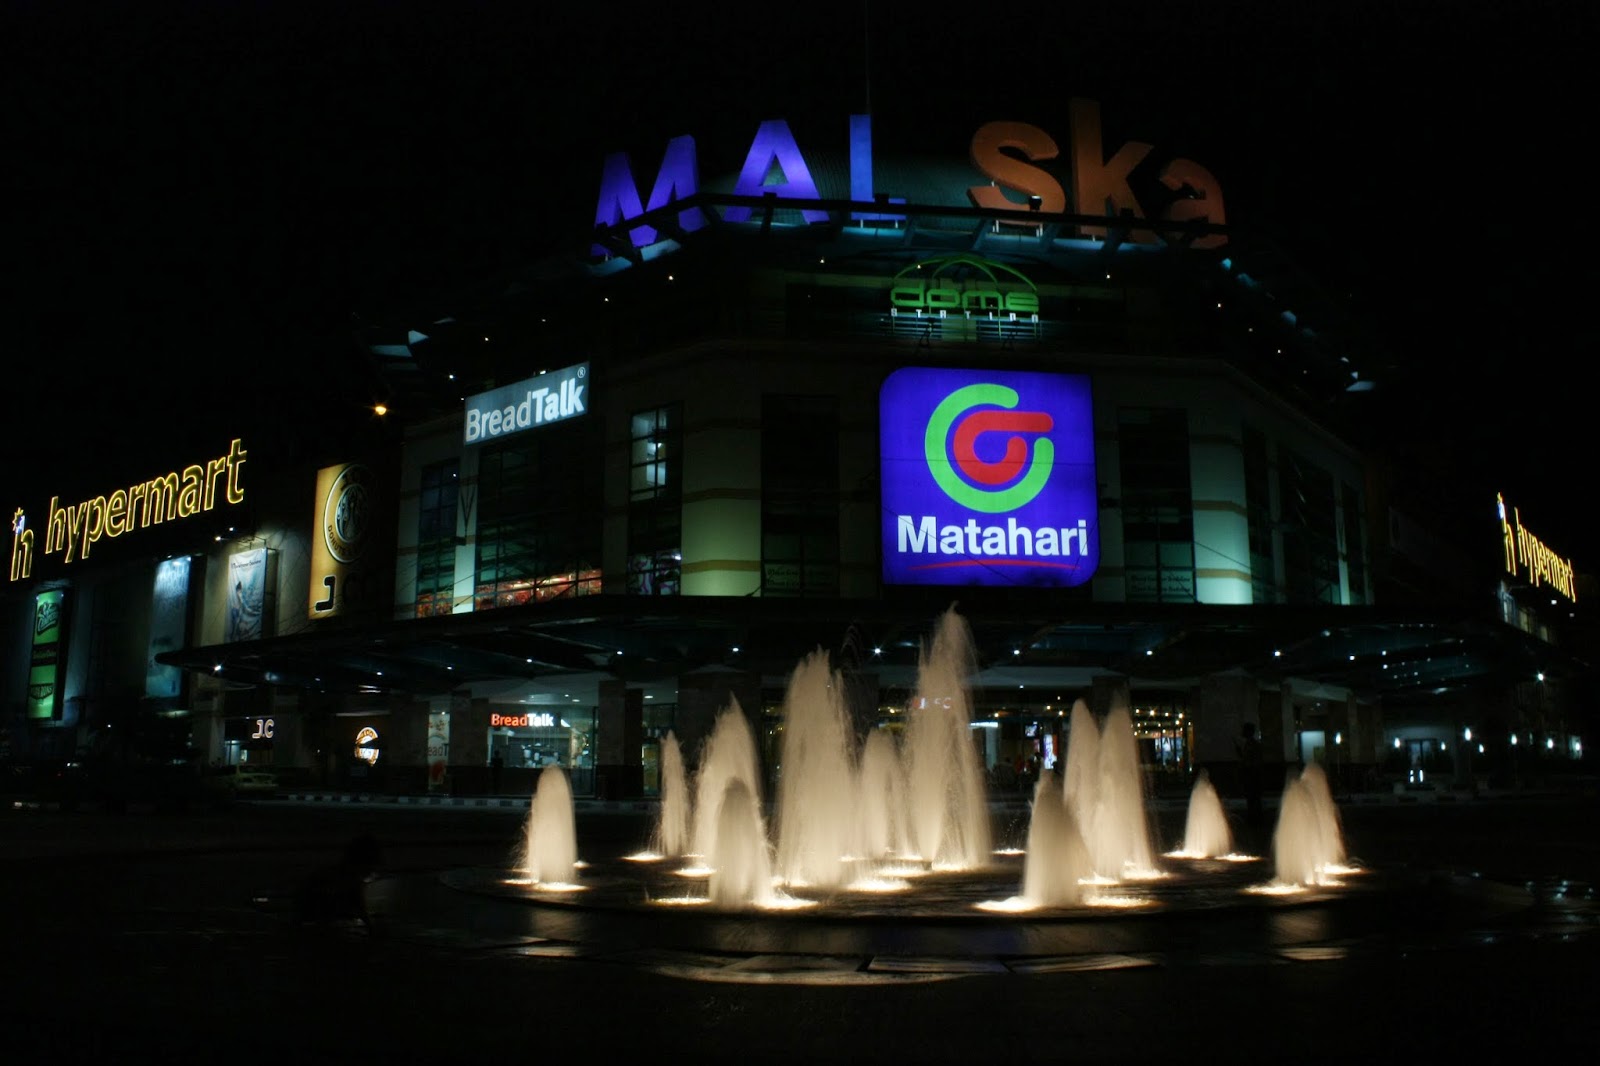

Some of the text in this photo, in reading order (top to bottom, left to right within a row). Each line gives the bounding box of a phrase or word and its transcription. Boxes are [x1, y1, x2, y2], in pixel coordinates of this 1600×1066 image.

[591, 113, 907, 256] MAL
[890, 282, 1040, 312] dome
[465, 376, 585, 442] BreadTalk
[44, 437, 248, 565] hypermart
[896, 515, 1090, 558] Matahari
[1514, 505, 1577, 604] hypermart
[490, 711, 555, 728] BreadTalk
